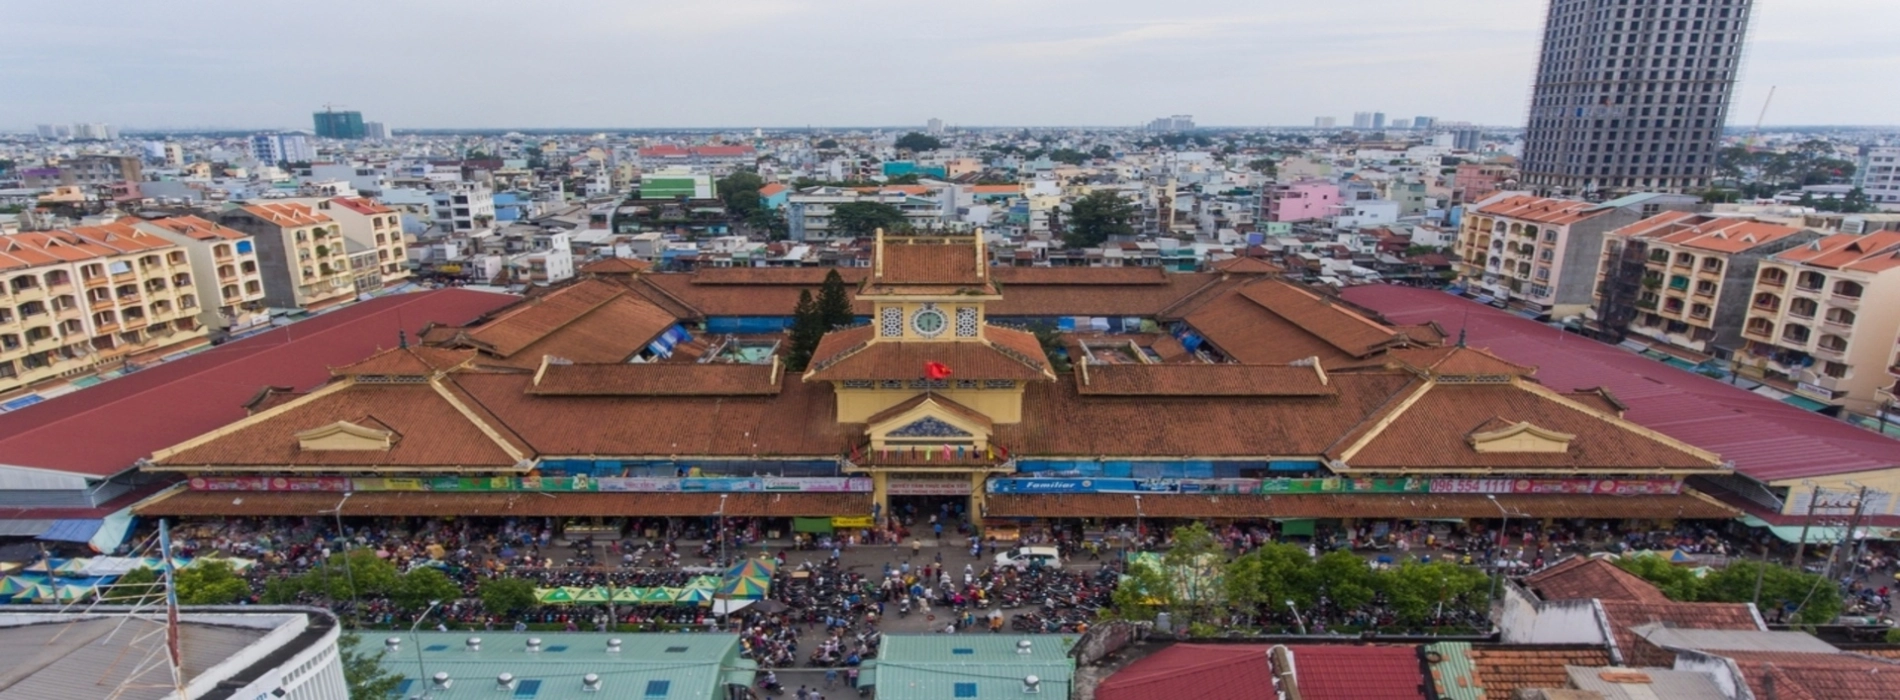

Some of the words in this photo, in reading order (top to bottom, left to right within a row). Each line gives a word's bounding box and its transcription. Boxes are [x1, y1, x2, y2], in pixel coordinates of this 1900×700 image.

[1026, 481, 1076, 489] Familiar
[1431, 480, 1453, 492] 096
[1457, 480, 1480, 492] 554
[1484, 480, 1514, 492] 1111
